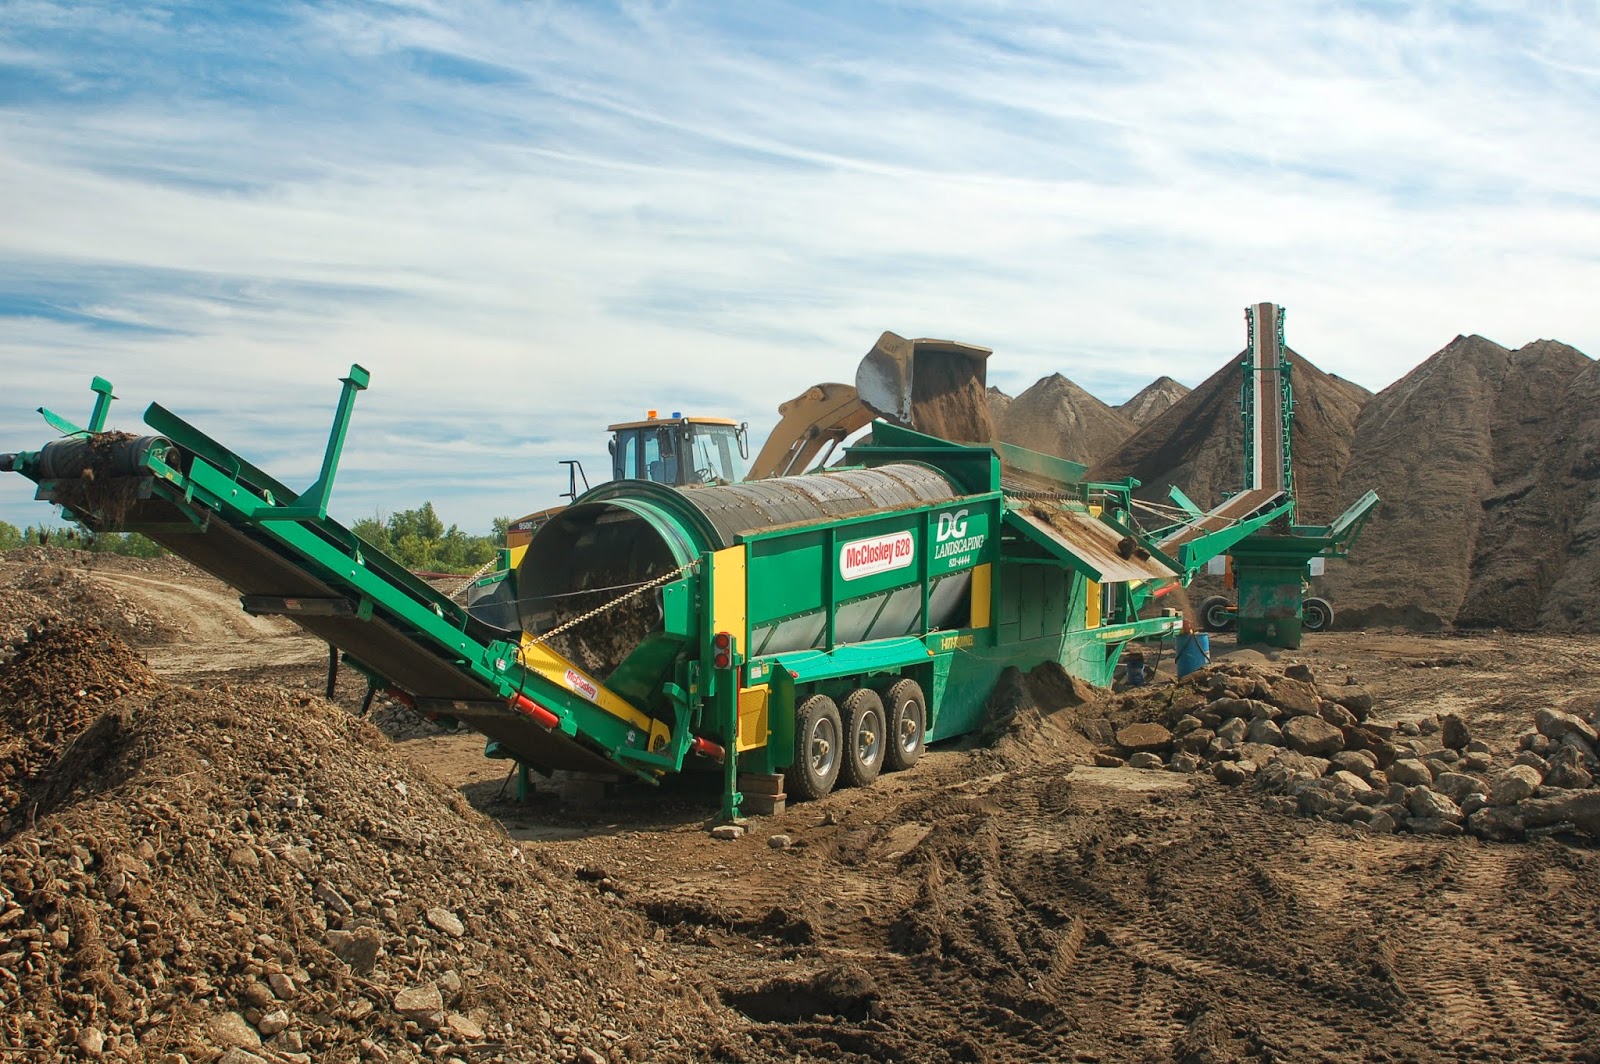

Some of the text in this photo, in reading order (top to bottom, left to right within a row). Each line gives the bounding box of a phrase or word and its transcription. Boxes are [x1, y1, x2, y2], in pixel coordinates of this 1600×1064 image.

[846, 537, 911, 569] McCloskey 628
[934, 534, 985, 560] LANDSCAPING
